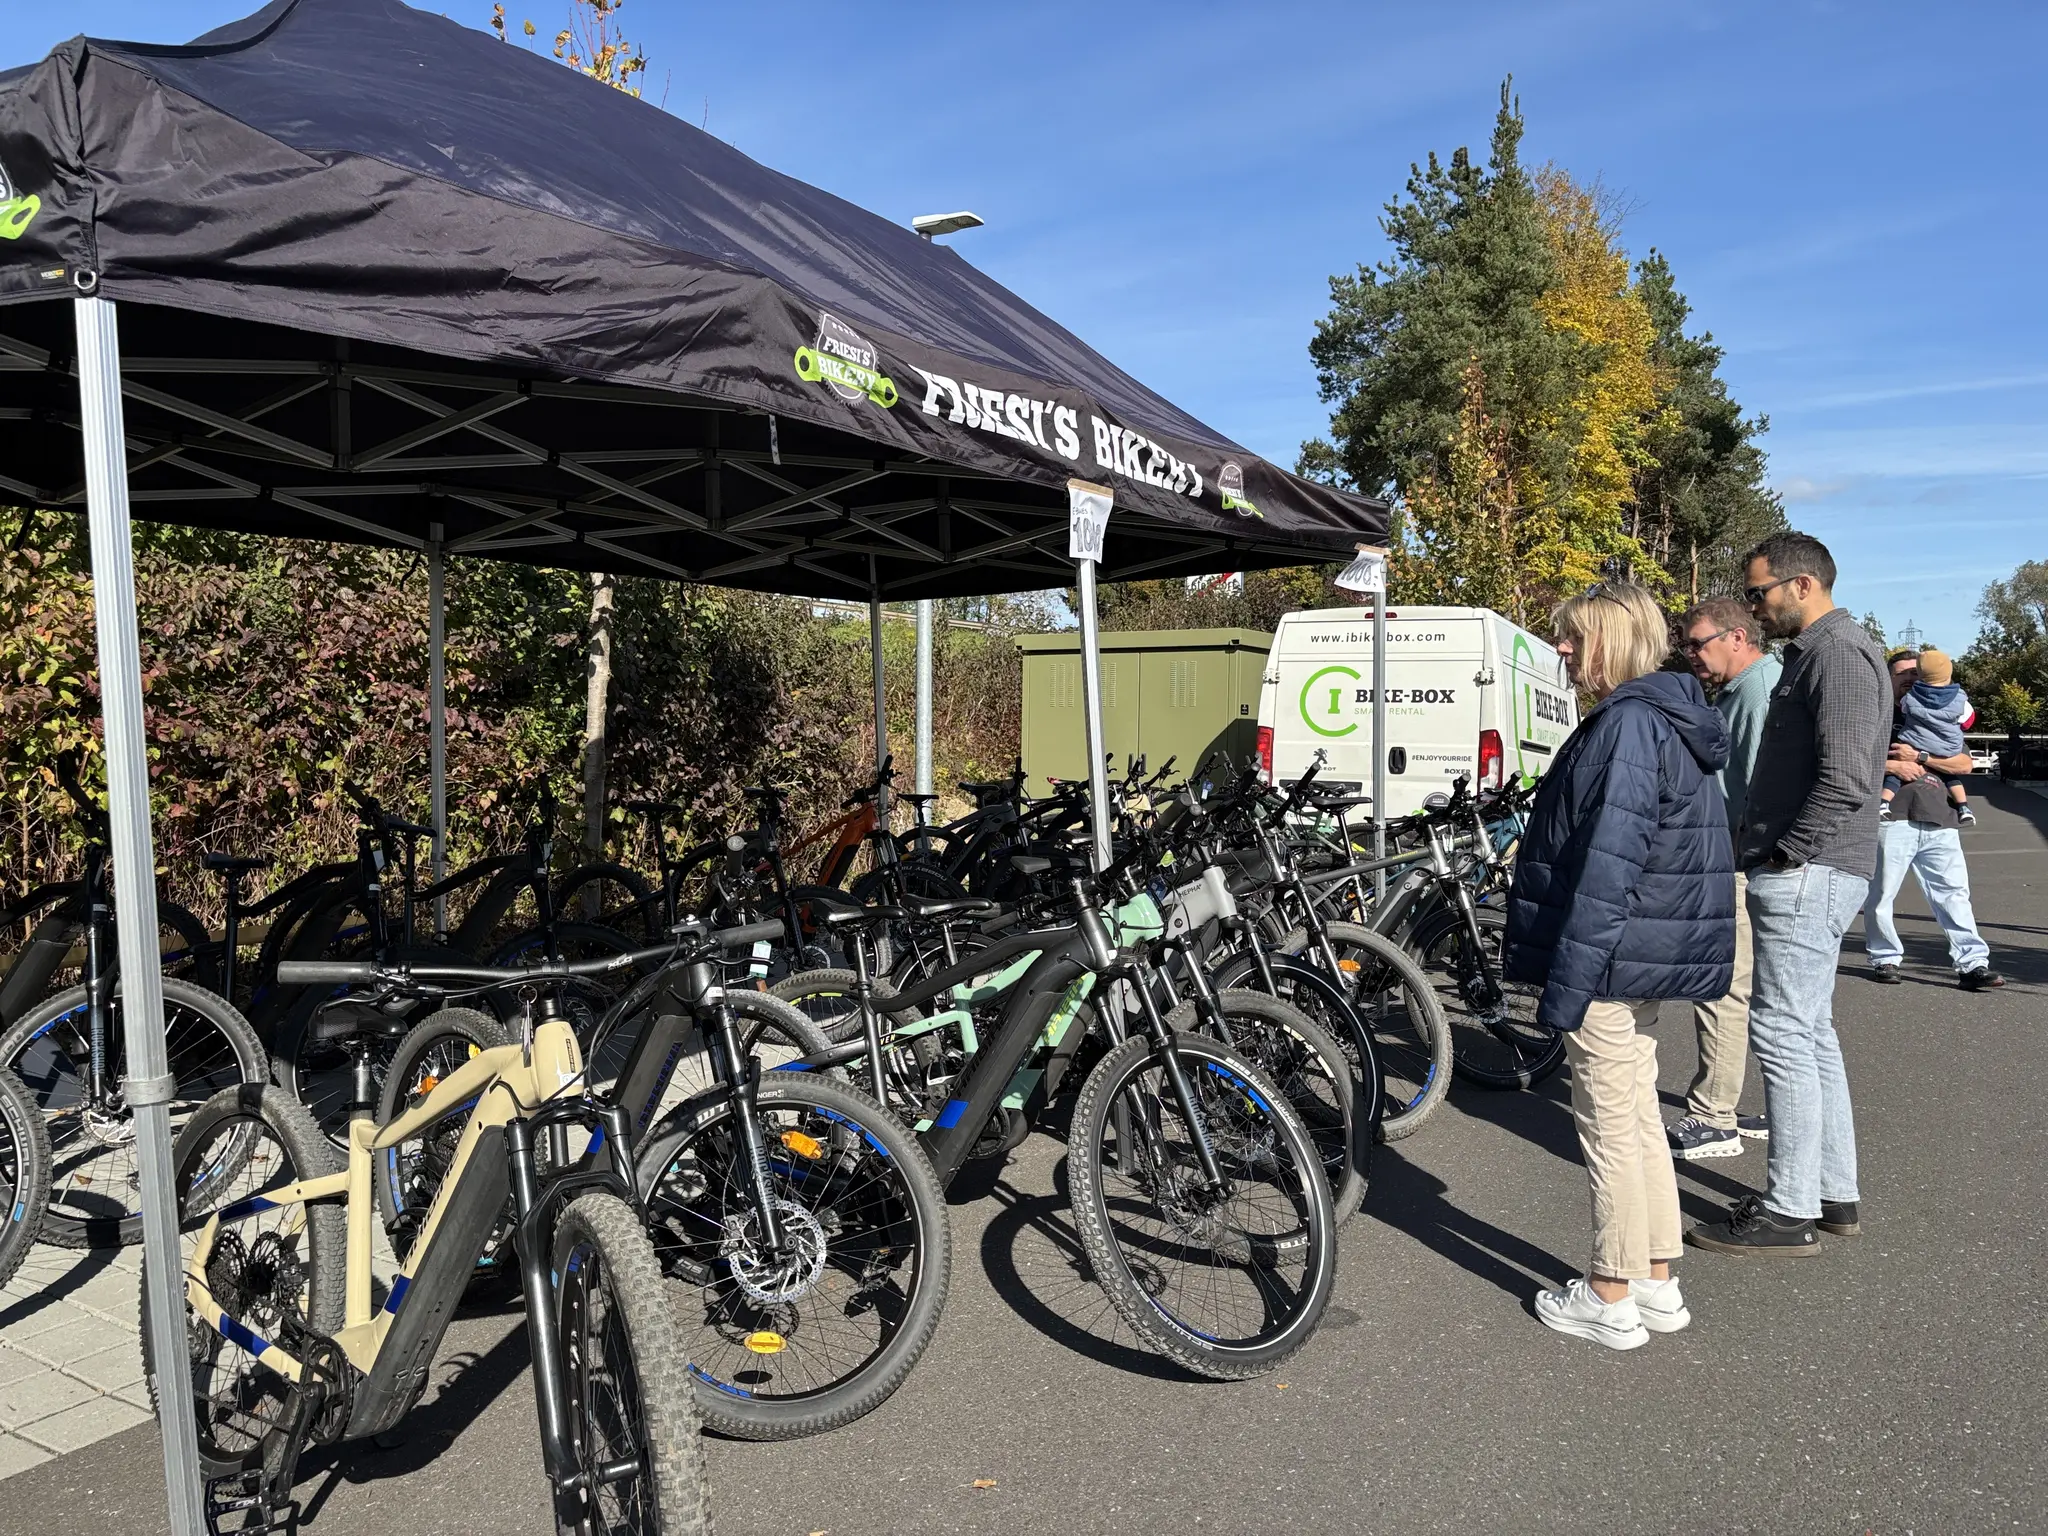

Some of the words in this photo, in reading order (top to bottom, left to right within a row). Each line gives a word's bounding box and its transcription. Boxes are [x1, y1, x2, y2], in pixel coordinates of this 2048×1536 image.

[823, 336, 871, 367] FRIESI'S
[817, 355, 877, 391] BIKERY
[1310, 631, 1446, 643] www.ibikbox.com
[1388, 708, 1425, 716] RENTAL
[1535, 688, 1570, 727] BIKE-BOX
[1411, 754, 1473, 762] #ENJOYYOURRIDE
